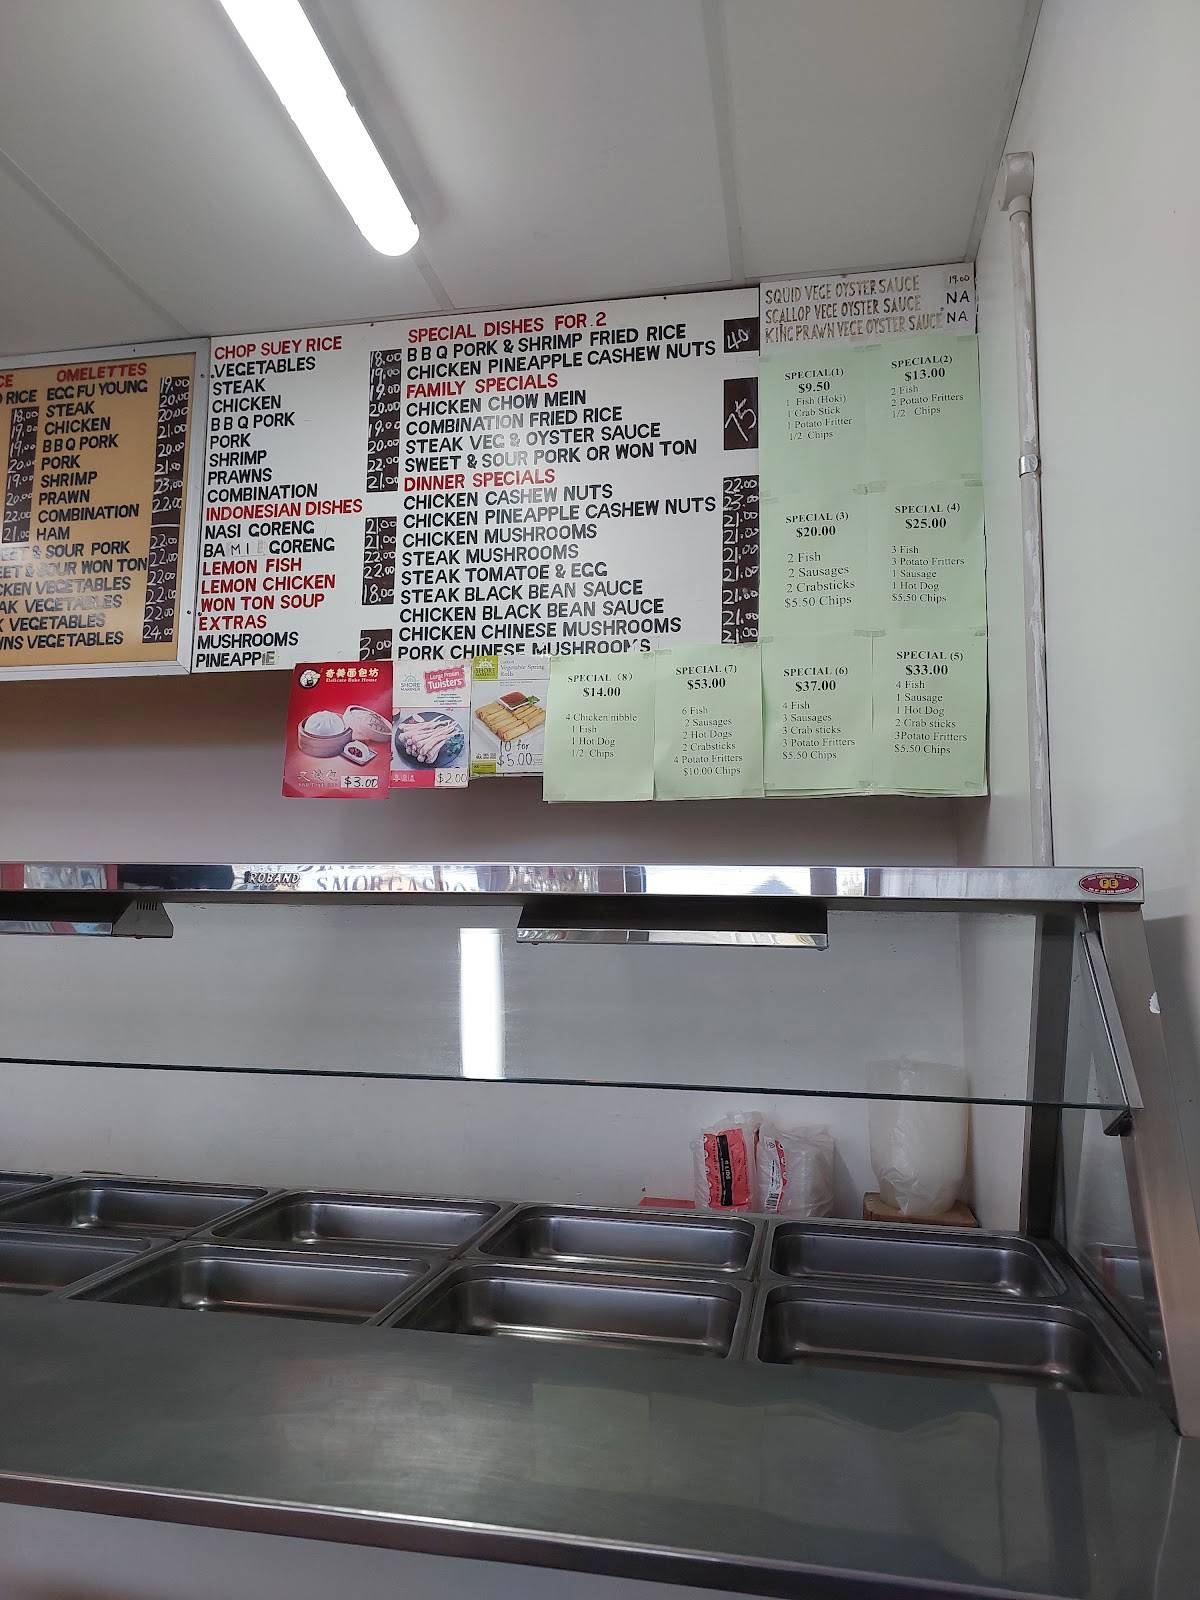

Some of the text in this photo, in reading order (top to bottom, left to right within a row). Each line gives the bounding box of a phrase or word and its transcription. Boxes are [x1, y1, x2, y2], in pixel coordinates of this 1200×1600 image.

[765, 287, 800, 304] SQUID
[836, 279, 876, 297] OYSTER
[879, 275, 919, 293] SAUCE
[766, 306, 810, 324] SCALLOP
[841, 298, 878, 316] OYSTER
[883, 295, 920, 313] SAUCE
[408, 312, 606, 343] SPECIAL DISHES FOR 2
[798, 323, 835, 342] PRAWN
[866, 316, 905, 334] OYSTER
[909, 312, 943, 330] SAUCE
[215, 336, 342, 360] CHOP SUEY RICE
[215, 357, 316, 377] VEGETABLES
[407, 341, 716, 380] CHICKEN PINEAPPLE CASHEW NUTS
[57, 363, 147, 383] OMELETTES
[904, 368, 945, 382] $13.00
[77, 383, 96, 398] FU
[213, 378, 265, 395] STEAK
[407, 373, 558, 398] FAMILY SPECIALS
[798, 381, 830, 394] $9.50
[212, 395, 281, 413] CHICKEN
[406, 390, 585, 417] CHICKEN CHOW MEIN
[796, 397, 814, 406] Fish
[900, 393, 963, 406] Potato Fritters
[46, 402, 94, 417] STEAK
[45, 418, 110, 434] CHICKEN
[406, 406, 622, 435] COMBINATION FRIED RICE
[210, 433, 251, 449] PORK
[406, 437, 463, 454] STEAK
[510, 433, 520, 447] &
[526, 428, 595, 446] OYSTER
[601, 423, 660, 441] SAUCE
[41, 456, 80, 470] PORK
[209, 450, 267, 467] SHRIMP
[405, 439, 696, 472] SWEET & SOUR PORK OR WON TON
[40, 472, 97, 487] SHRIMP
[208, 468, 272, 485] PRAWNS
[404, 469, 555, 491] DINNER SPECIALS
[39, 490, 90, 505] PRAWN
[207, 483, 317, 503] COMBINATION
[404, 484, 613, 510] CHICKEN CASHEW NUTS
[38, 504, 139, 523] COMBINATION
[206, 499, 363, 521] INDONESIAN DISHES
[895, 505, 943, 514] SPECIAL
[786, 514, 832, 524] SPECIAL
[905, 518, 946, 529] $25.00
[37, 527, 69, 540] HAM
[205, 524, 241, 539] NASI
[403, 524, 597, 547] CHICKEN MUSHROOMS
[796, 526, 836, 538] $20.00
[203, 558, 302, 576] LEMON FISH
[401, 562, 608, 585] STEAK TOMATOE & EGG
[798, 567, 850, 578] Sausages
[201, 575, 335, 594] LEMON CHICKEN
[401, 580, 643, 604] STEAK BLACK BEAN SAUCE
[796, 580, 855, 592] Crabsticks
[900, 581, 939, 591] Hot Dog
[200, 594, 324, 613] WON TON SOUP
[199, 615, 267, 631] EXTRAS
[400, 617, 681, 641] CHICKEN CHINESE MUSHROOMS
[198, 632, 298, 649] MUSHROOMS
[896, 651, 946, 660] SPECIAL
[676, 665, 721, 675] SPECIAL
[783, 667, 832, 677] SPECIAL
[906, 665, 948, 675] $33.00
[428, 678, 462, 690] Twisters
[567, 674, 611, 683] SPECIAL
[688, 678, 725, 689] $53.00
[796, 680, 836, 691] $37.00
[583, 687, 621, 697] $14.00
[904, 694, 943, 703] Sausage
[517, 740, 529, 750] for
[497, 753, 532, 767] $5.00
[344, 776, 378, 788] $3.00
[438, 773, 467, 784] $2.00
[250, 873, 300, 884] ROBAND
